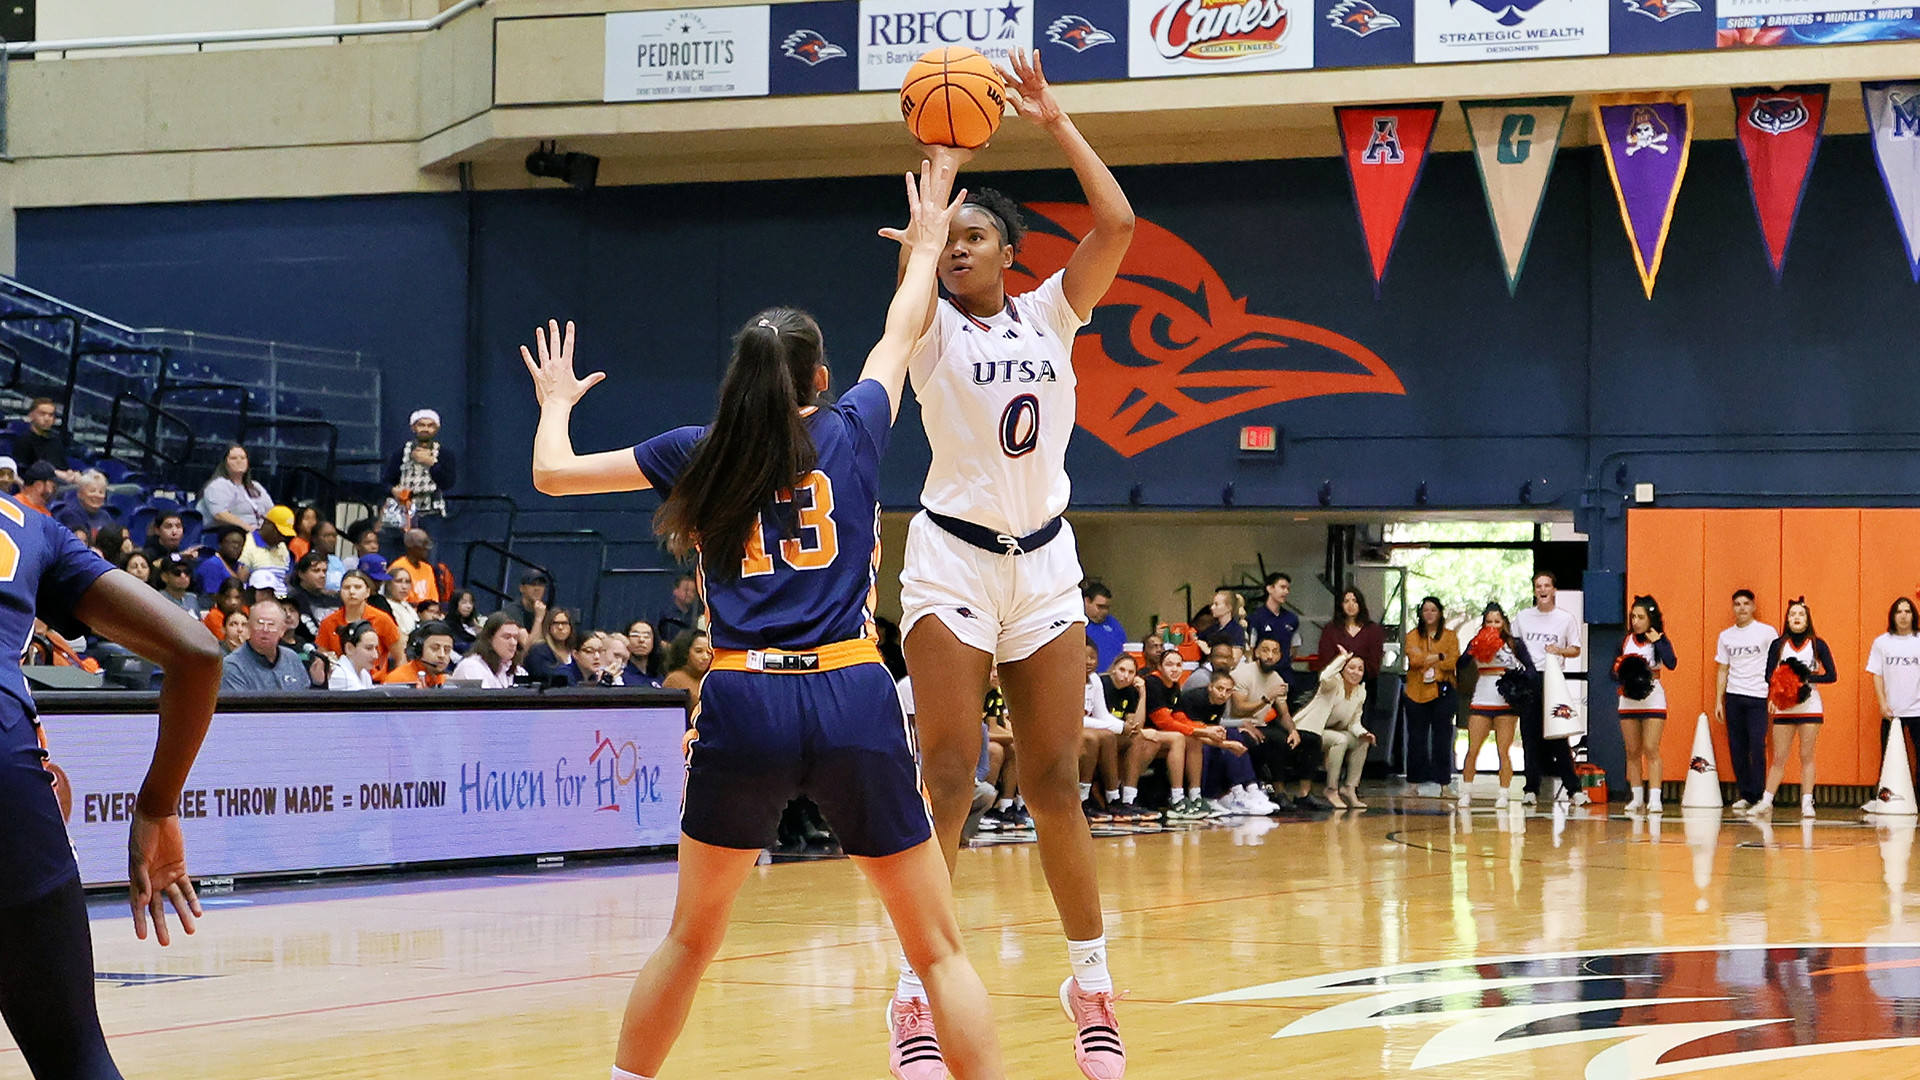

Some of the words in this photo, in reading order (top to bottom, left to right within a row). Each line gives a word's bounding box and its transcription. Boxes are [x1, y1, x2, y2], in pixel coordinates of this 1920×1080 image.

[867, 8, 993, 46] RBFCU
[1727, 17, 1757, 29] SIGNS
[1767, 13, 1814, 27] BANNERS
[1824, 11, 1866, 23] MURALS
[1877, 8, 1913, 20] WRAPS
[1439, 29, 1521, 43] STRATEGIC
[1526, 27, 1584, 39] WEALTH
[638, 40, 734, 68] PEDROTTI'S
[1486, 44, 1539, 53] DESIGNERS
[666, 69, 704, 81] RANCH
[972, 359, 1057, 385] UTSA
[1527, 633, 1558, 643] UTSA
[1729, 646, 1760, 657] UTSA
[1885, 656, 1920, 665] UTSA
[459, 761, 546, 814] Haven
[556, 757, 587, 807] for
[595, 741, 662, 825] Hope
[85, 792, 137, 823] EVER
[214, 787, 276, 817] THROW
[284, 785, 334, 814] MADE
